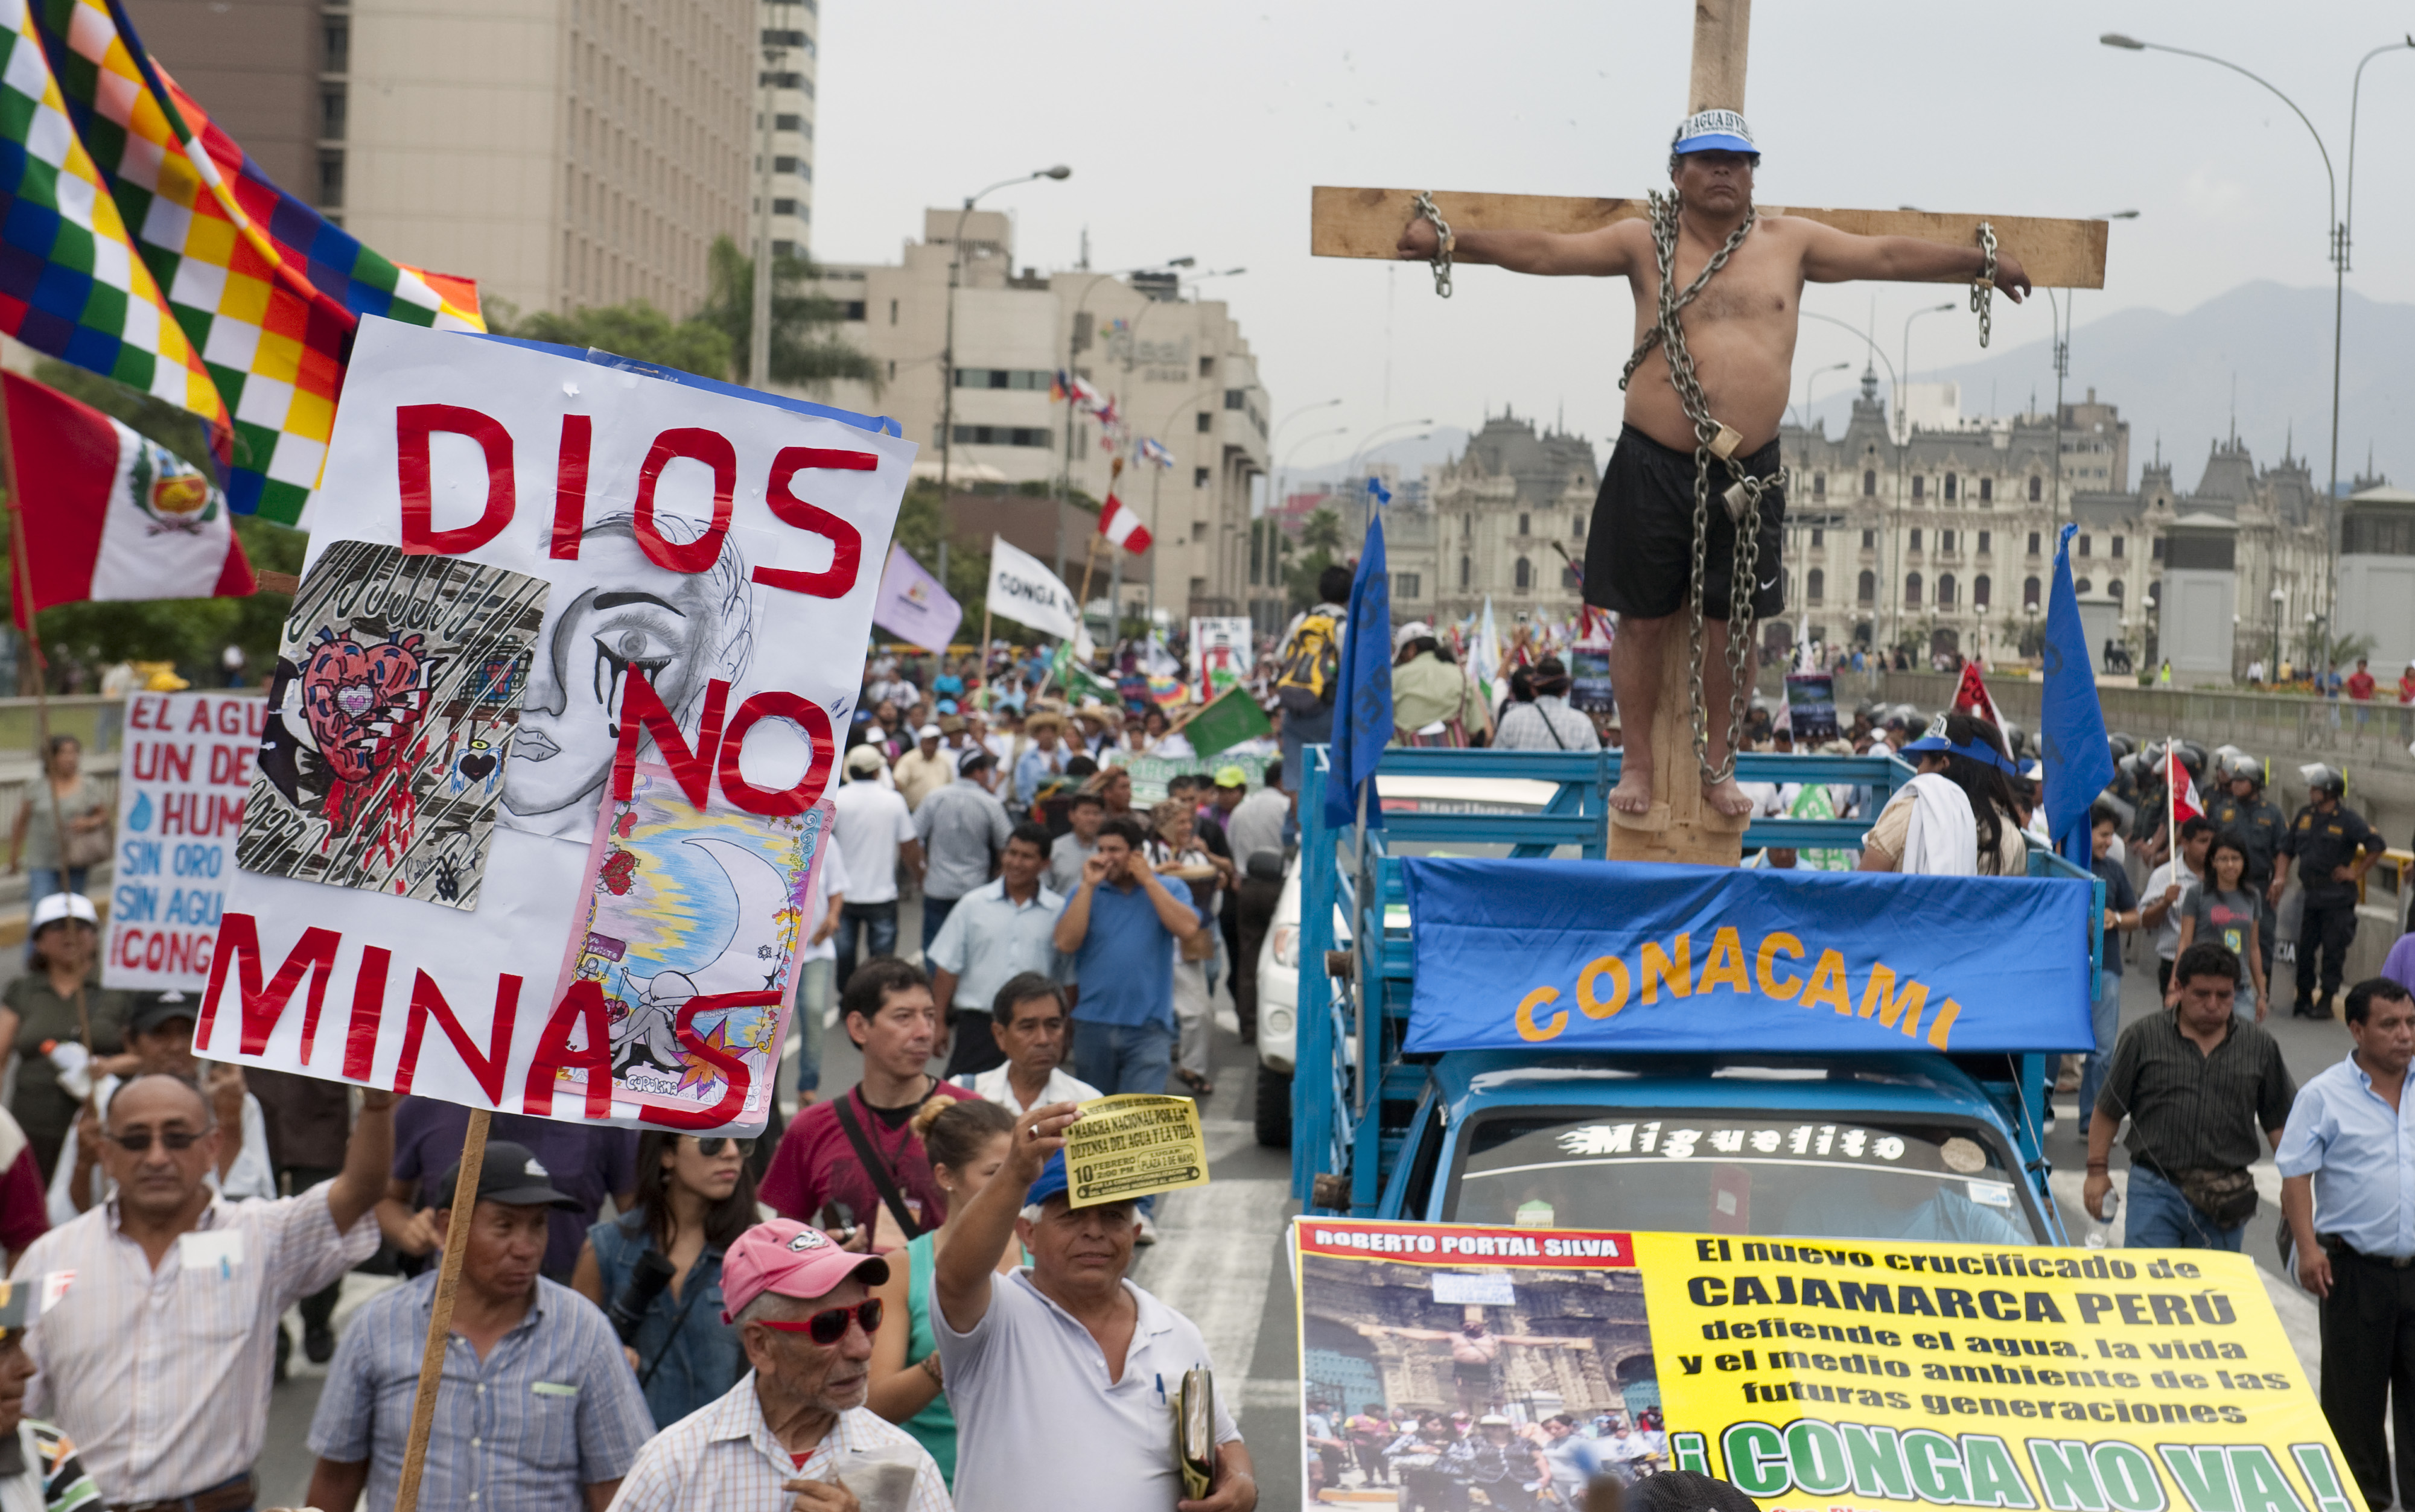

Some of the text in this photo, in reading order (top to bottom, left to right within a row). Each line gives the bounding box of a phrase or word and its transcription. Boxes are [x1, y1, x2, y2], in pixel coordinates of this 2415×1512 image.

[1694, 112, 1723, 128] AGUA
[396, 403, 879, 599] DIOS
[999, 571, 1056, 607] CONGA
[131, 698, 173, 731] EL
[612, 661, 835, 817] NO
[133, 742, 255, 787] UN DE
[161, 792, 246, 837] HUM
[173, 843, 223, 878] ORO
[1515, 926, 1962, 1051] CONACAMI
[196, 913, 783, 1130] MINAS
[1071, 1124, 1195, 1160] DEFENSA DEL AGUA Y LA VIDA
[1074, 1108, 1186, 1139] MARCHA NACIONAL POR LA
[1556, 1122, 1905, 1160] Miguelito
[1074, 1157, 1136, 1184] 10 FEBRERO
[1097, 1169, 1117, 1178] 2:00
[1141, 1158, 1162, 1169] PLAZA
[1168, 1155, 1176, 1165] DE
[1177, 1152, 1195, 1164] MAYO
[1314, 1230, 1620, 1258] ROBERTO PORTAL SILVA
[1695, 1239, 2201, 1280] El nuevo crucificado de
[1687, 1275, 2238, 1326] CAJAMARCA PERÚ
[1702, 1318, 2248, 1360] defiende el agua, la vida
[1678, 1349, 2291, 1391] y el medio ambiente de las
[1742, 1382, 2248, 1425] futuras generaciones
[1720, 1418, 2041, 1510] CONGA
[2025, 1437, 2171, 1512] NO
[2155, 1443, 2311, 1512] VA
